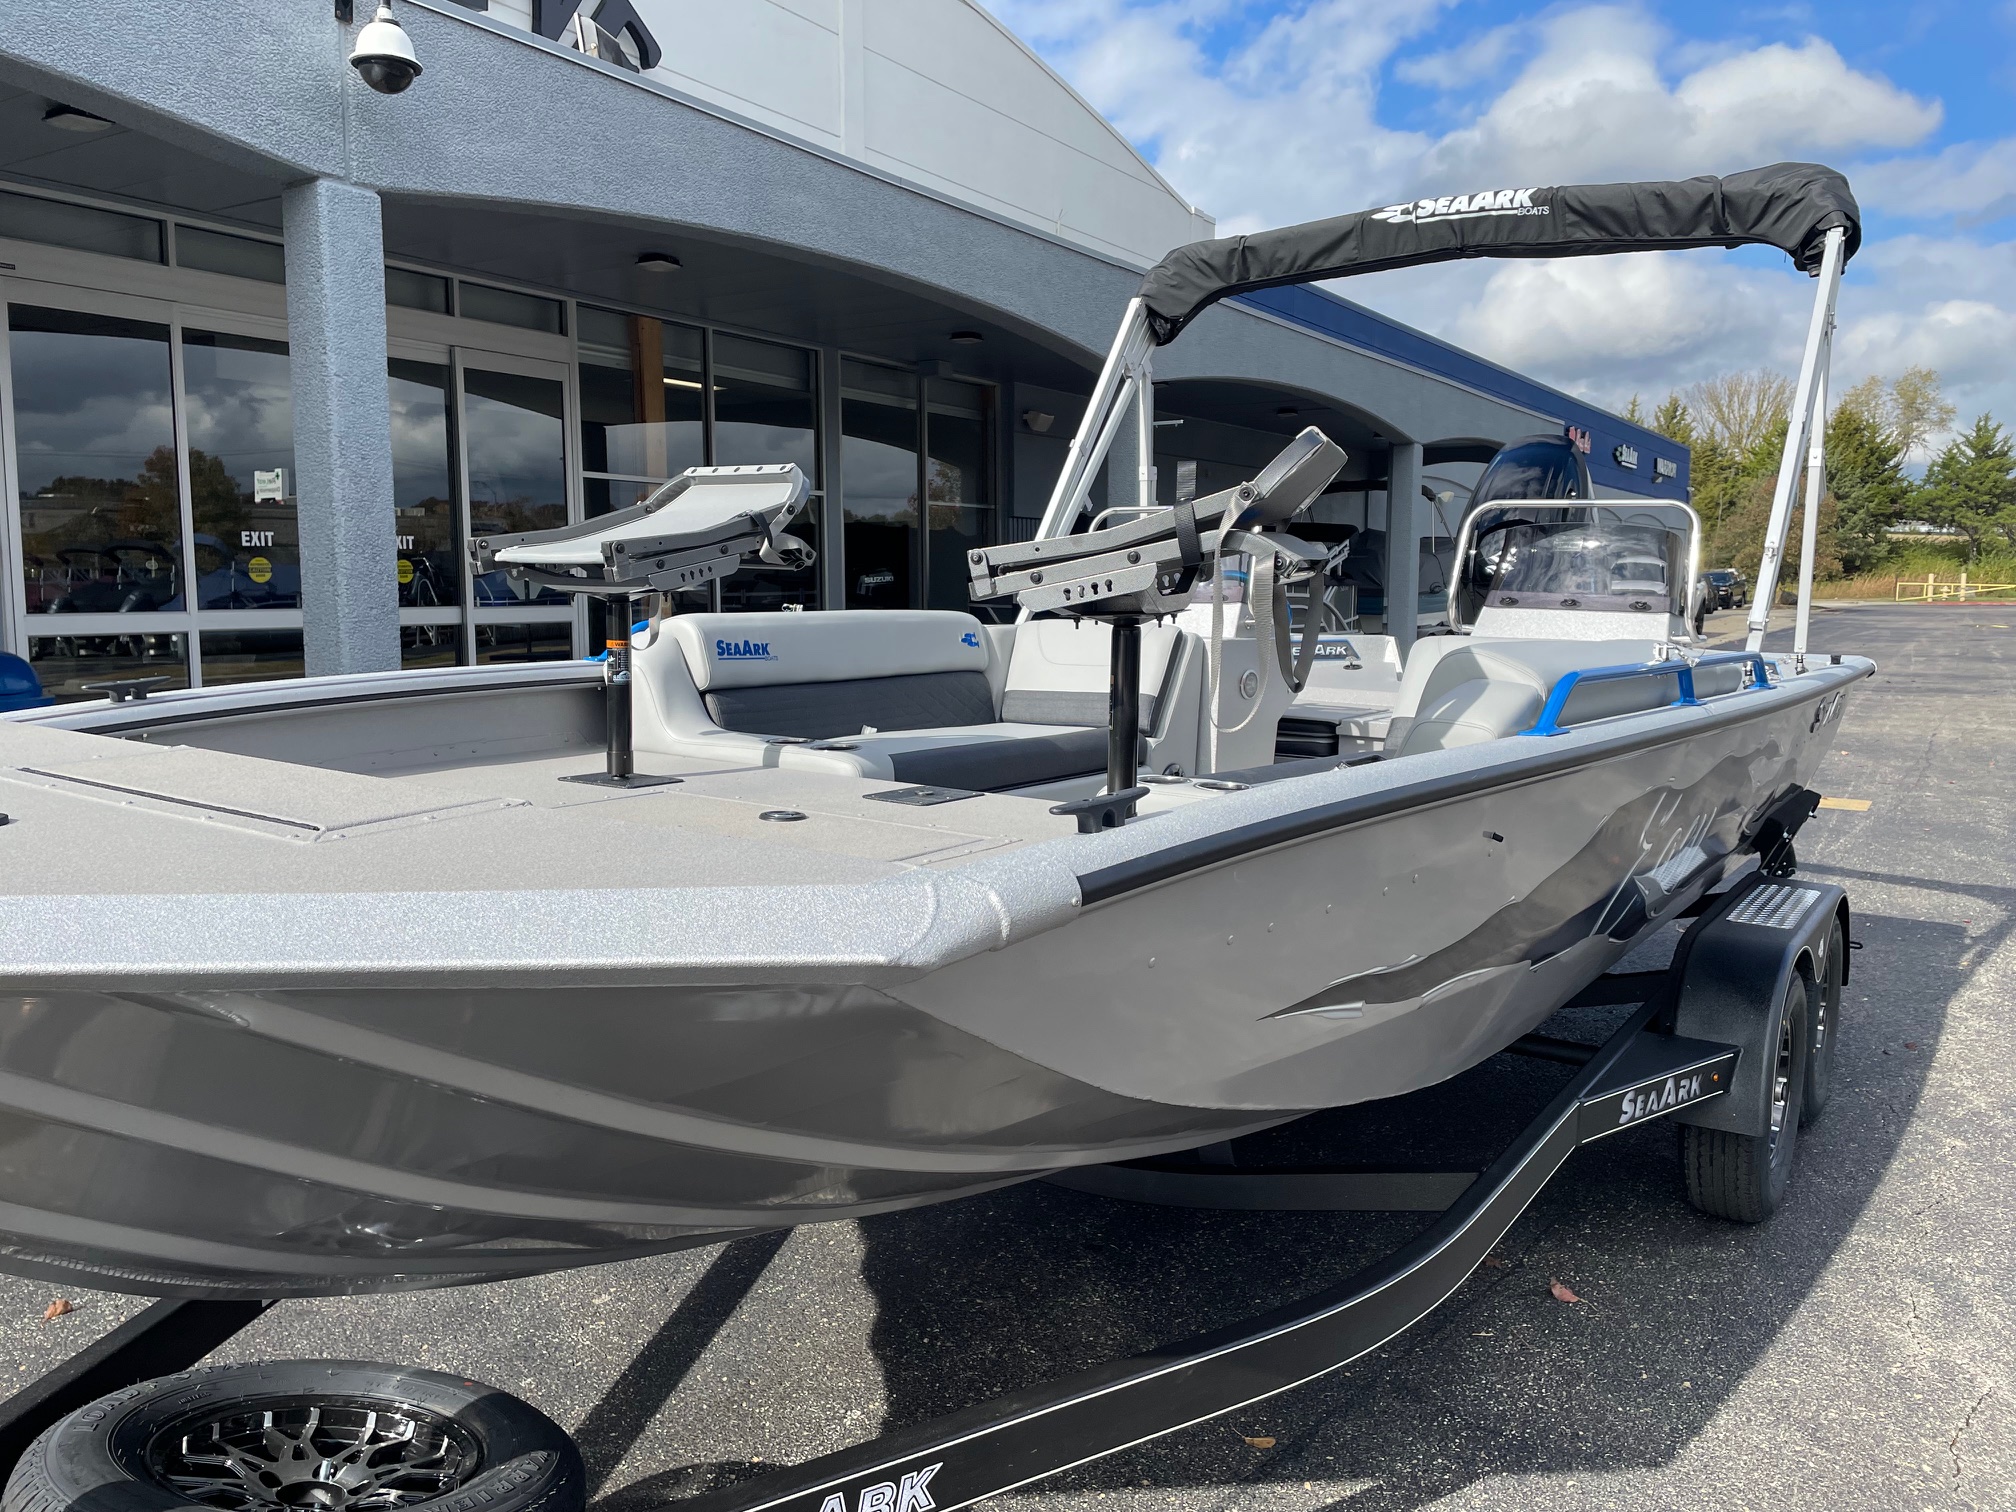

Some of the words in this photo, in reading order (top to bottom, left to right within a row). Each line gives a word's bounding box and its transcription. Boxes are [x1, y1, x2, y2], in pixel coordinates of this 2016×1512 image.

[1416, 187, 1539, 218] SEAARK
[1517, 205, 1550, 217] BOATS
[241, 530, 275, 547] EXIT
[396, 535, 415, 550] XIT
[864, 576, 894, 584] SUZUKI
[716, 639, 771, 656] SEAARK
[1292, 644, 1347, 656] EARK
[1618, 1074, 1706, 1124] SEAARK
